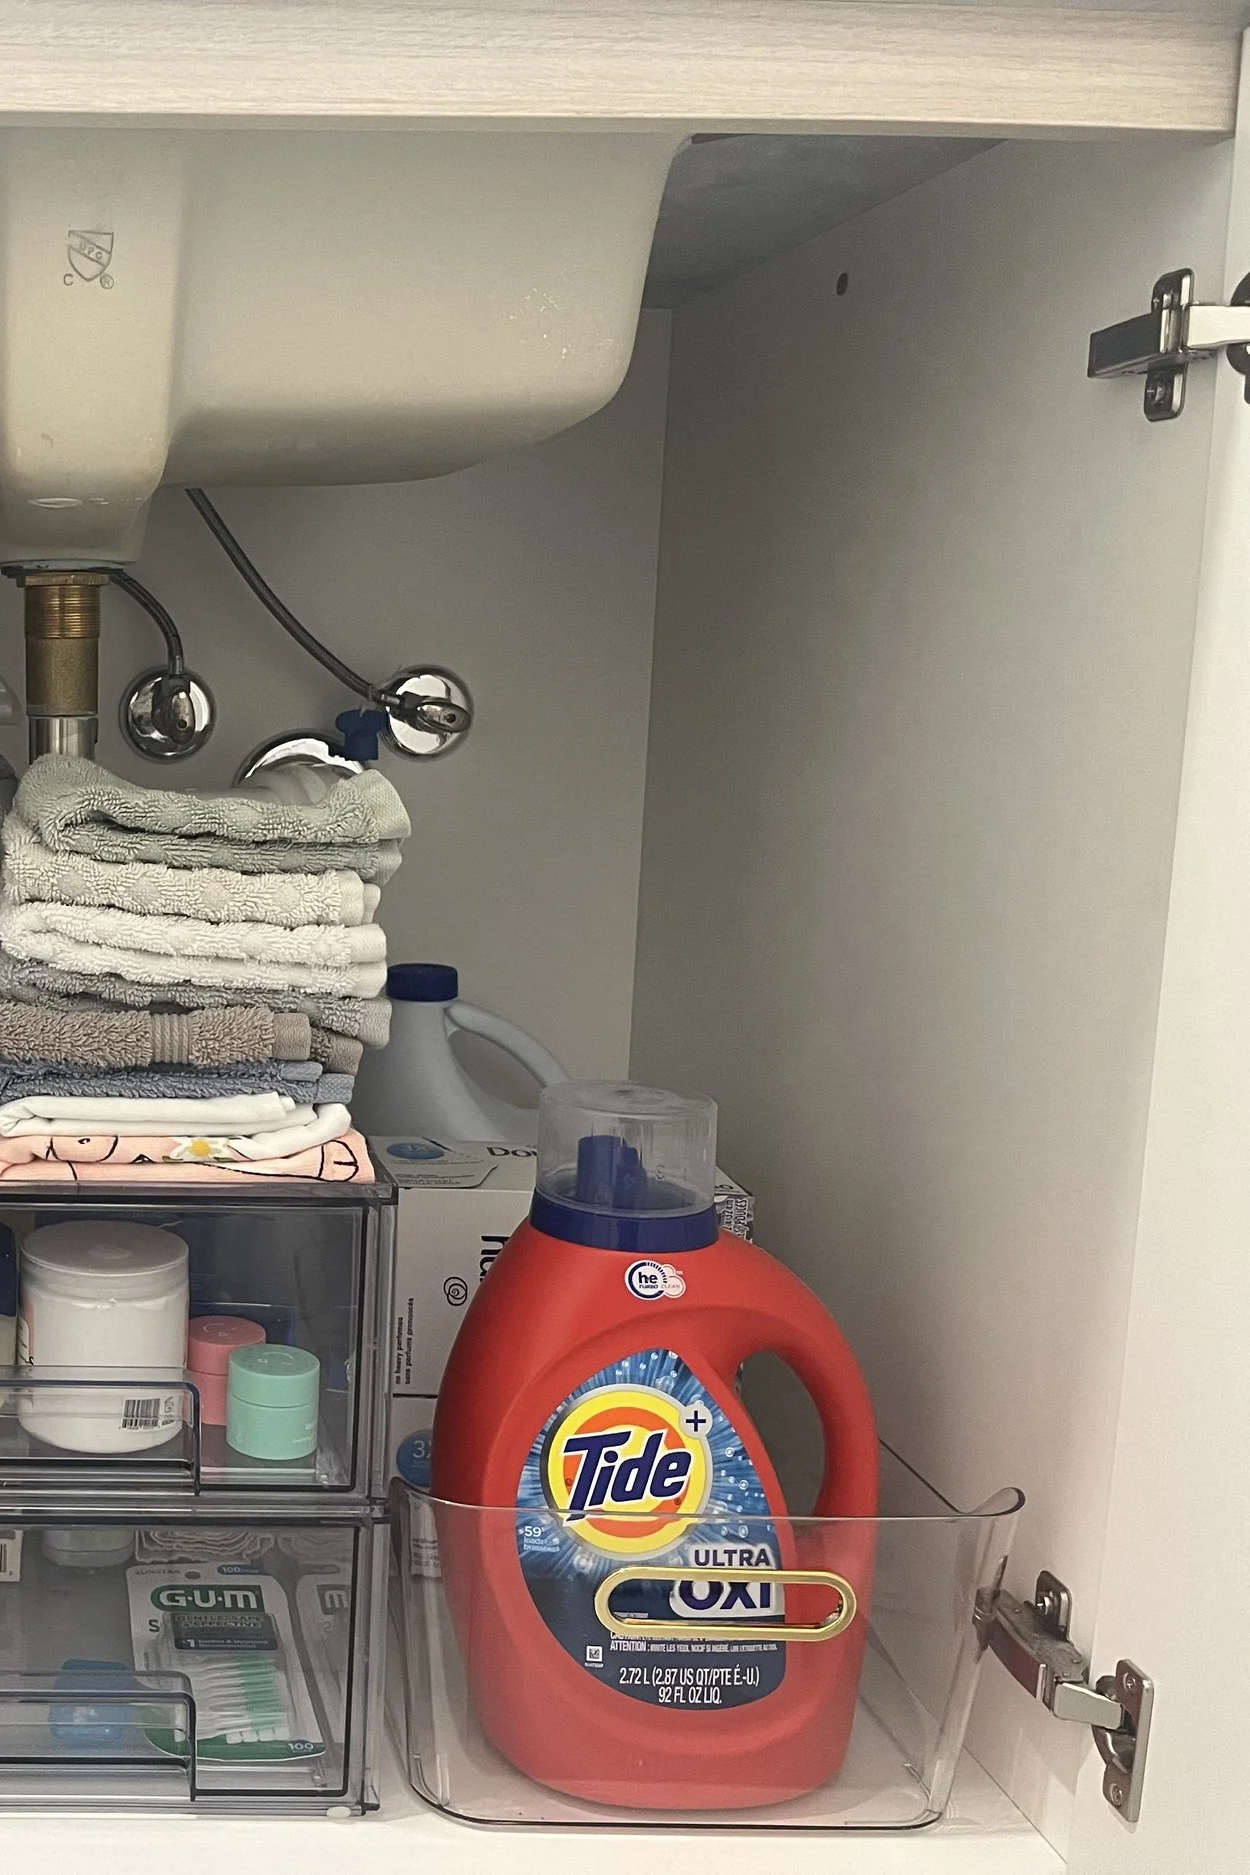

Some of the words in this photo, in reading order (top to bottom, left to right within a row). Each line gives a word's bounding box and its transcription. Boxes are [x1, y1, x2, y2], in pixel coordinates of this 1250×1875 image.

[638, 1272, 658, 1284] he
[395, 1352, 403, 1374] heavy
[564, 1431, 692, 1521] Tide
[524, 1526, 542, 1537] 59
[694, 1549, 771, 1567] ULTRA
[222, 1566, 240, 1574] 100
[678, 1582, 771, 1610] OXI
[610, 1641, 646, 1652] ATTENTION
[619, 1667, 641, 1685] 2.72
[643, 1667, 650, 1685] L
[652, 1666, 677, 1686] (2.87
[679, 1668, 694, 1685] US
[696, 1668, 732, 1686] QT/PTE
[658, 1687, 672, 1703] 92
[674, 1687, 686, 1703] FL
[688, 1687, 702, 1703] OZ
[703, 1687, 723, 1704] LIQ.
[288, 1742, 314, 1750] 100
